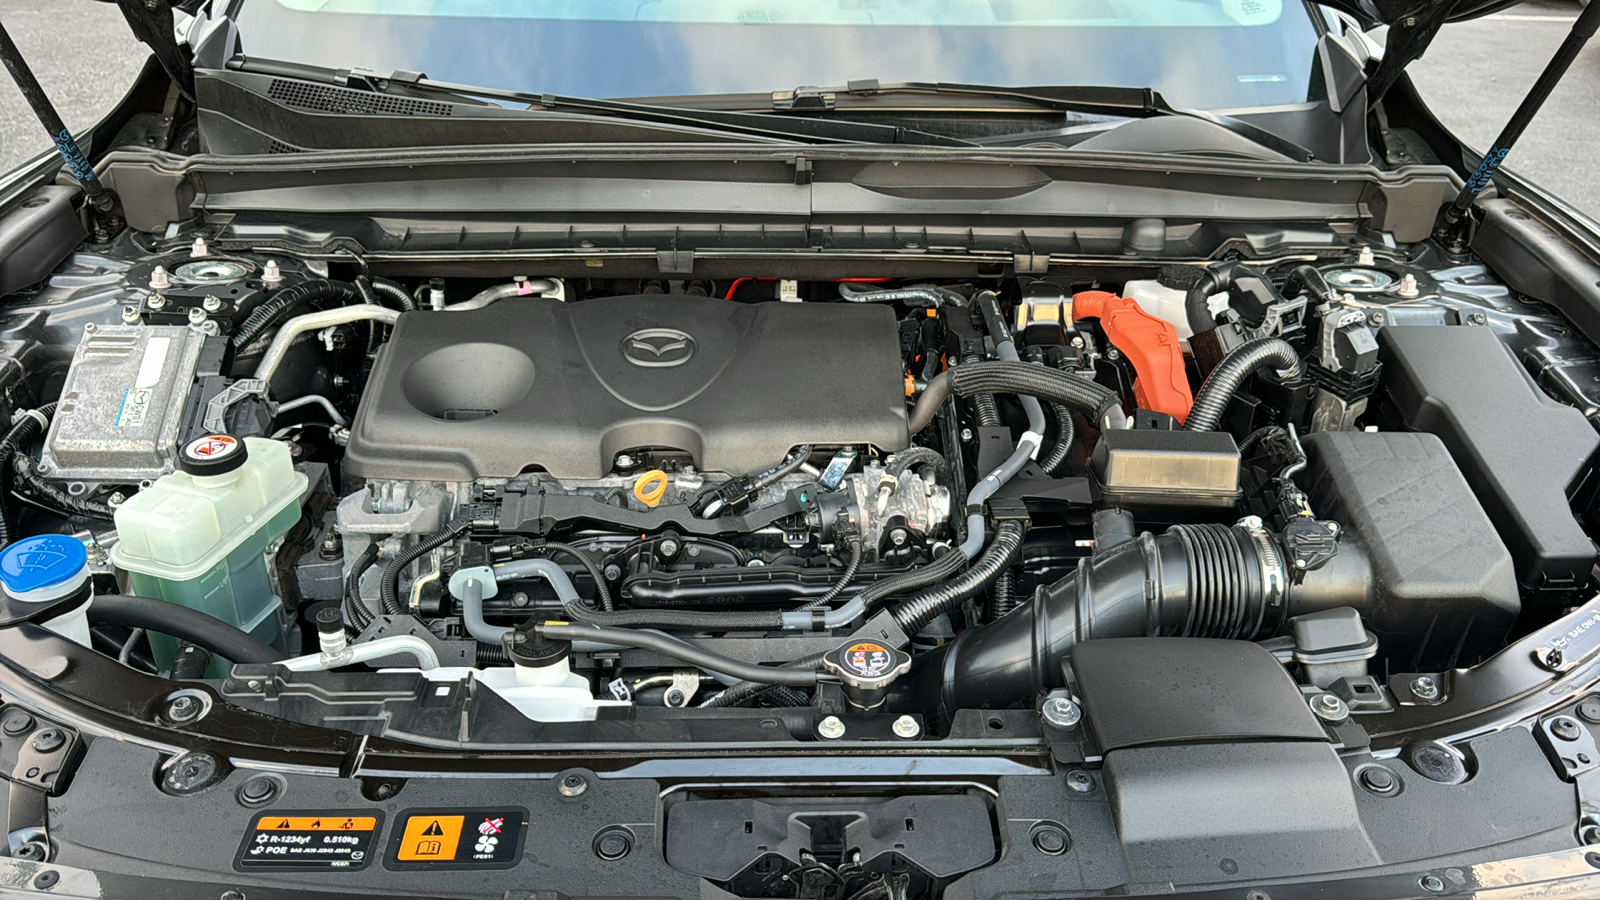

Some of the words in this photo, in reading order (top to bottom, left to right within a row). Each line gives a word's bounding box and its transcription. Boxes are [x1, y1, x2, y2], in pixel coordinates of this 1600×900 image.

[1567, 625, 1586, 638] SAE
[516, 647, 557, 657] COOLANT
[270, 835, 311, 845] R-1234yf
[323, 835, 359, 845] 0.510kg
[265, 846, 288, 854] POE
